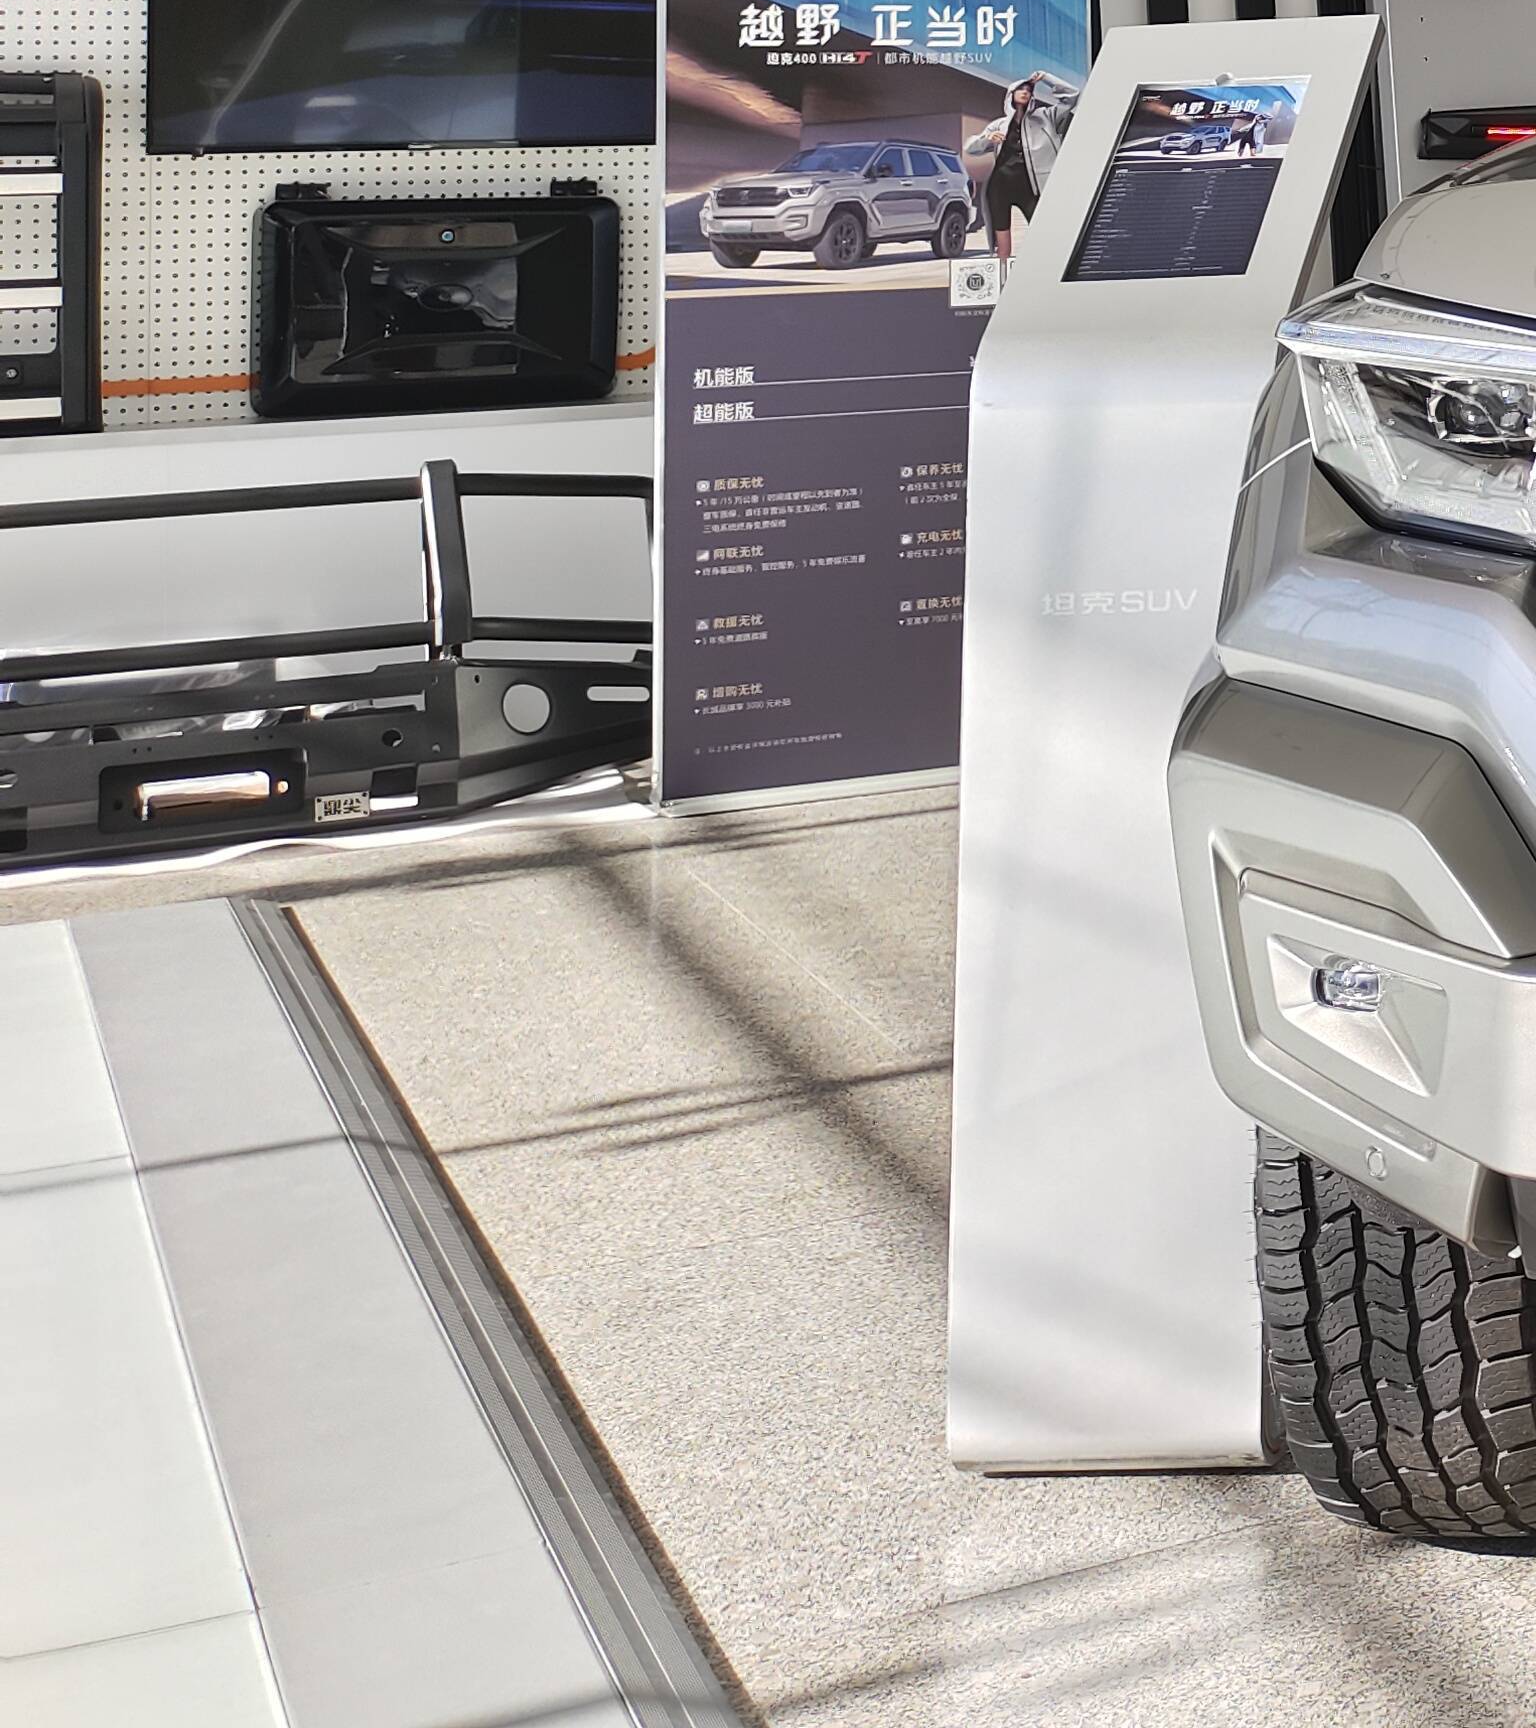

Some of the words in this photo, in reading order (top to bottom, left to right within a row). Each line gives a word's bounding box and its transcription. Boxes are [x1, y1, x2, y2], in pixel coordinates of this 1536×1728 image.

[739, 3, 841, 47] 越野
[870, 3, 1018, 47] 正当时
[766, 52, 817, 65] 坦克400
[694, 366, 755, 387] 机能版
[694, 401, 755, 423] 超能版
[916, 463, 964, 476] 保养无忧
[916, 529, 963, 544] 充电无忧
[1041, 588, 1198, 616] 坦克SUV
[713, 614, 764, 630] 救援无忧
